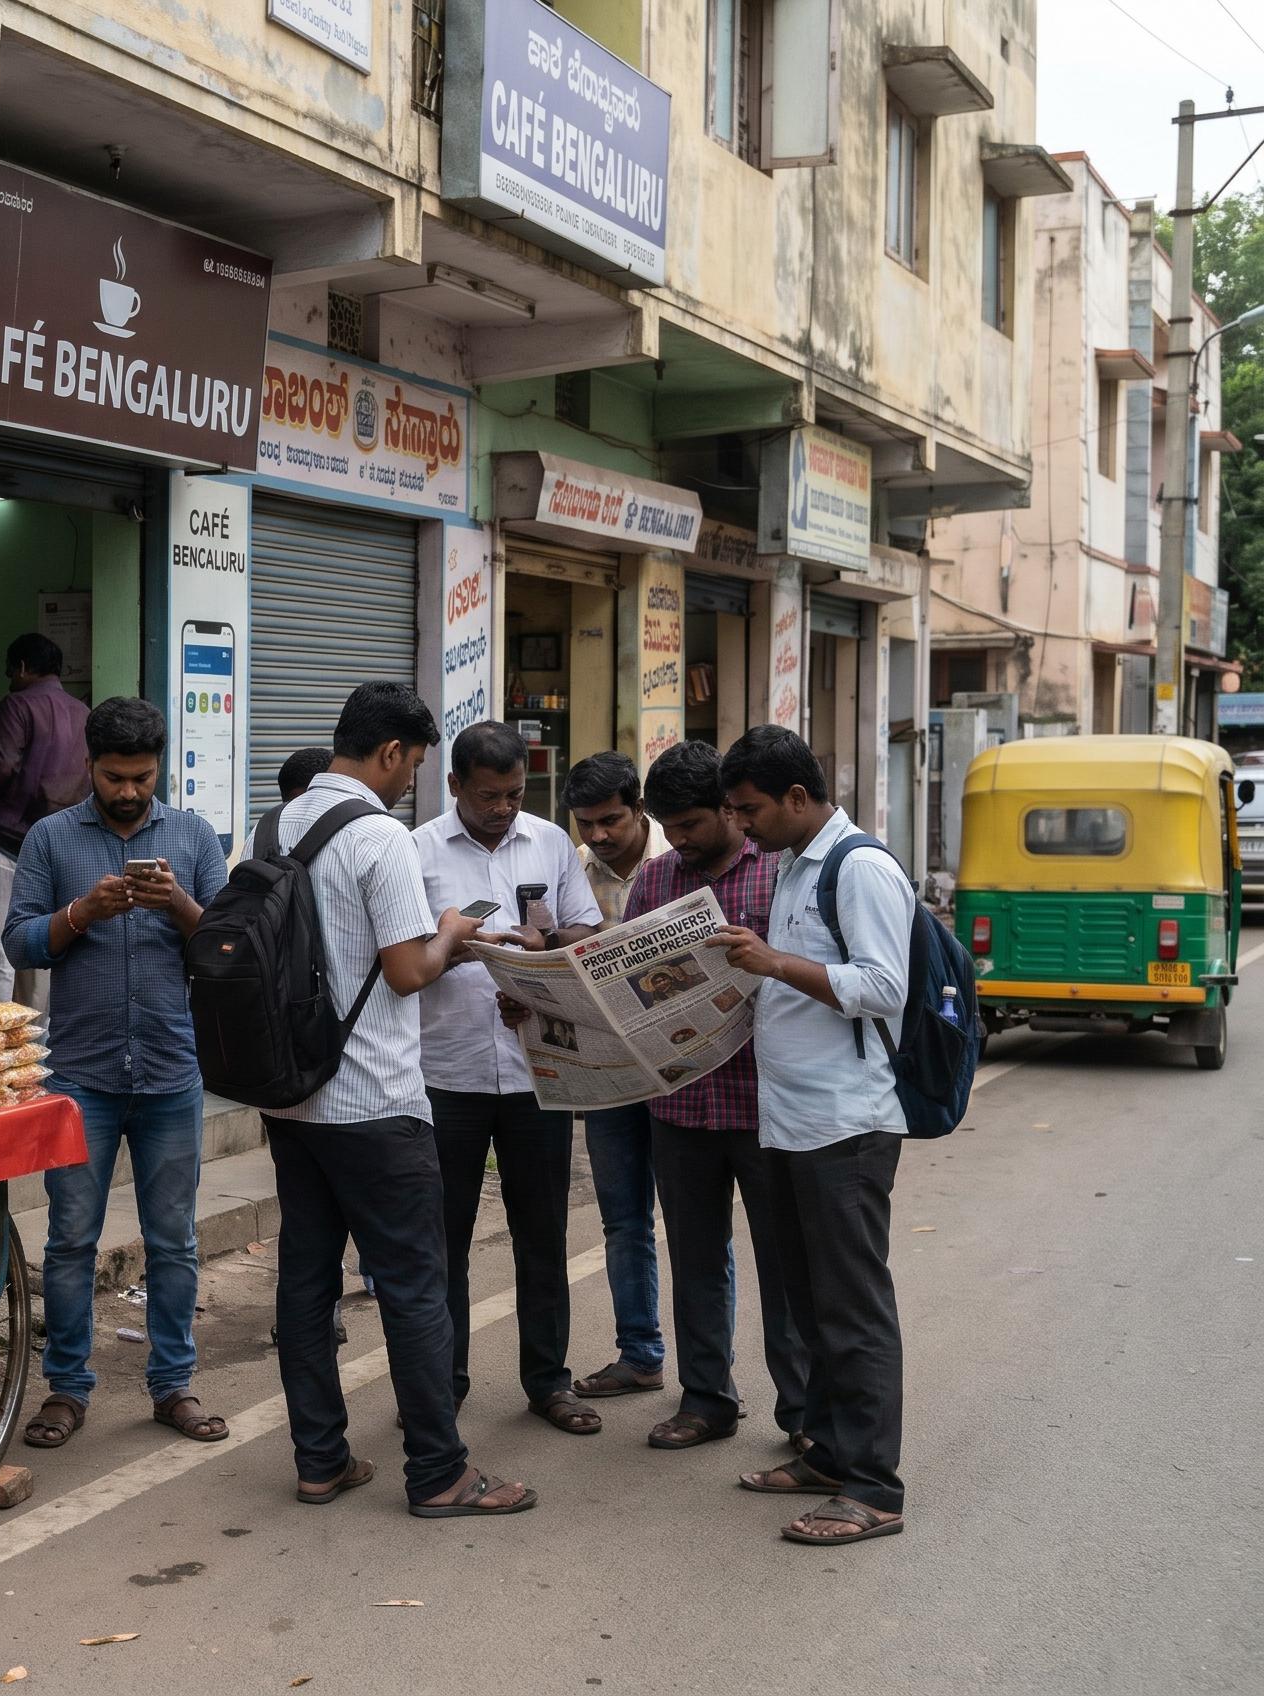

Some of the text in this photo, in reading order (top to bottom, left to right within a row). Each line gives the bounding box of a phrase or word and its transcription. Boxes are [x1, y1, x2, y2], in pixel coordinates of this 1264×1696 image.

[491, 80, 546, 167] CAFÉ
[551, 114, 662, 232] BENGALURU
[54, 340, 252, 437] BENGALURU
[189, 507, 230, 539] CAFÉ
[628, 908, 712, 951] CONTROVERSY
